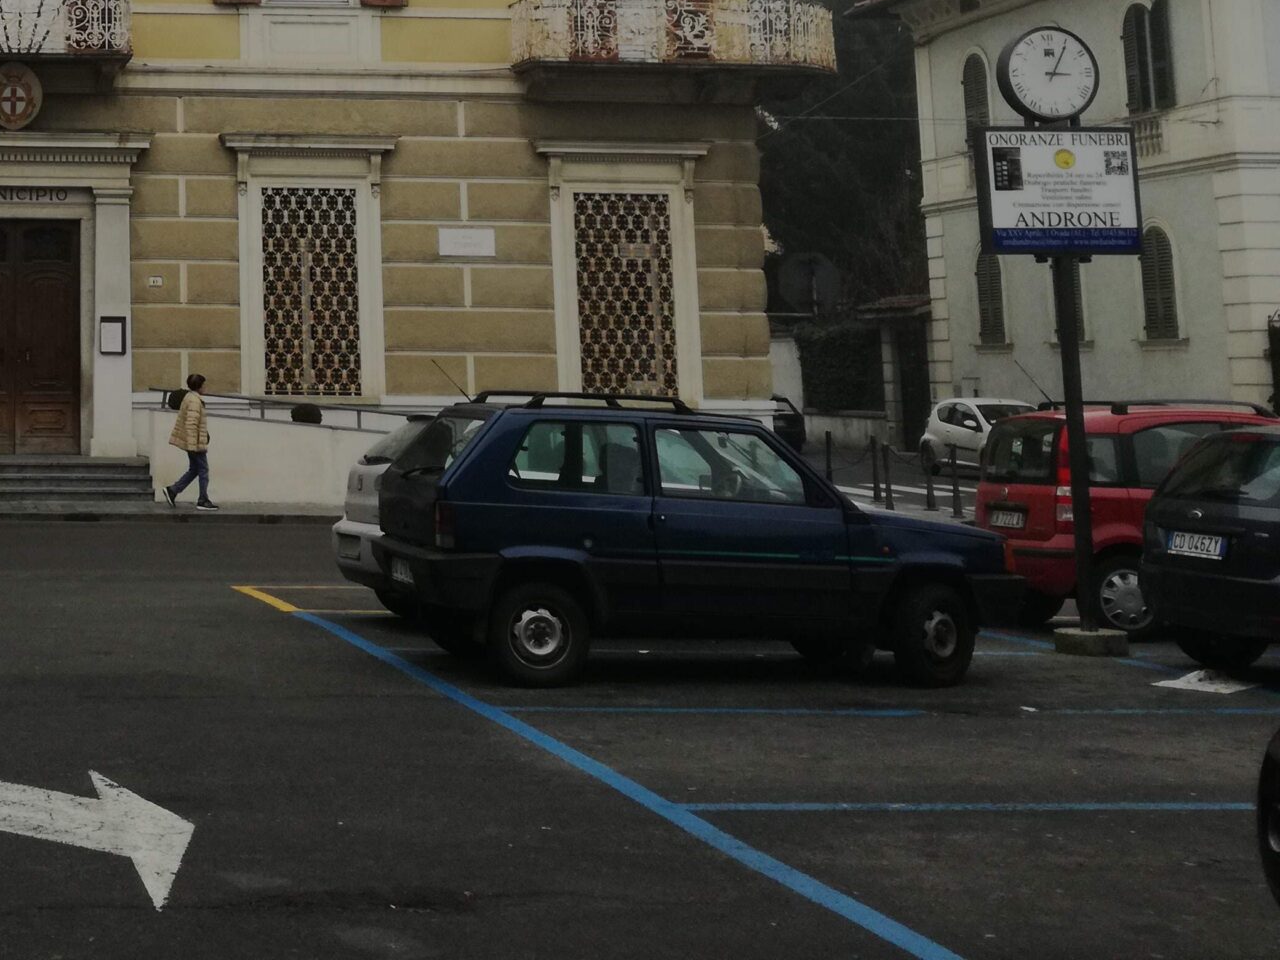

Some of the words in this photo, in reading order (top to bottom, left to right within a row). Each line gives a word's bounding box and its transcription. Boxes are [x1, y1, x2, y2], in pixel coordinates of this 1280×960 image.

[988, 133, 1064, 146] ONORANZE
[1071, 134, 1129, 146] FUNEBRI
[1015, 211, 1122, 228] ANDRONE
[1173, 533, 1186, 549] CD
[1187, 535, 1221, 553] 046ZY
